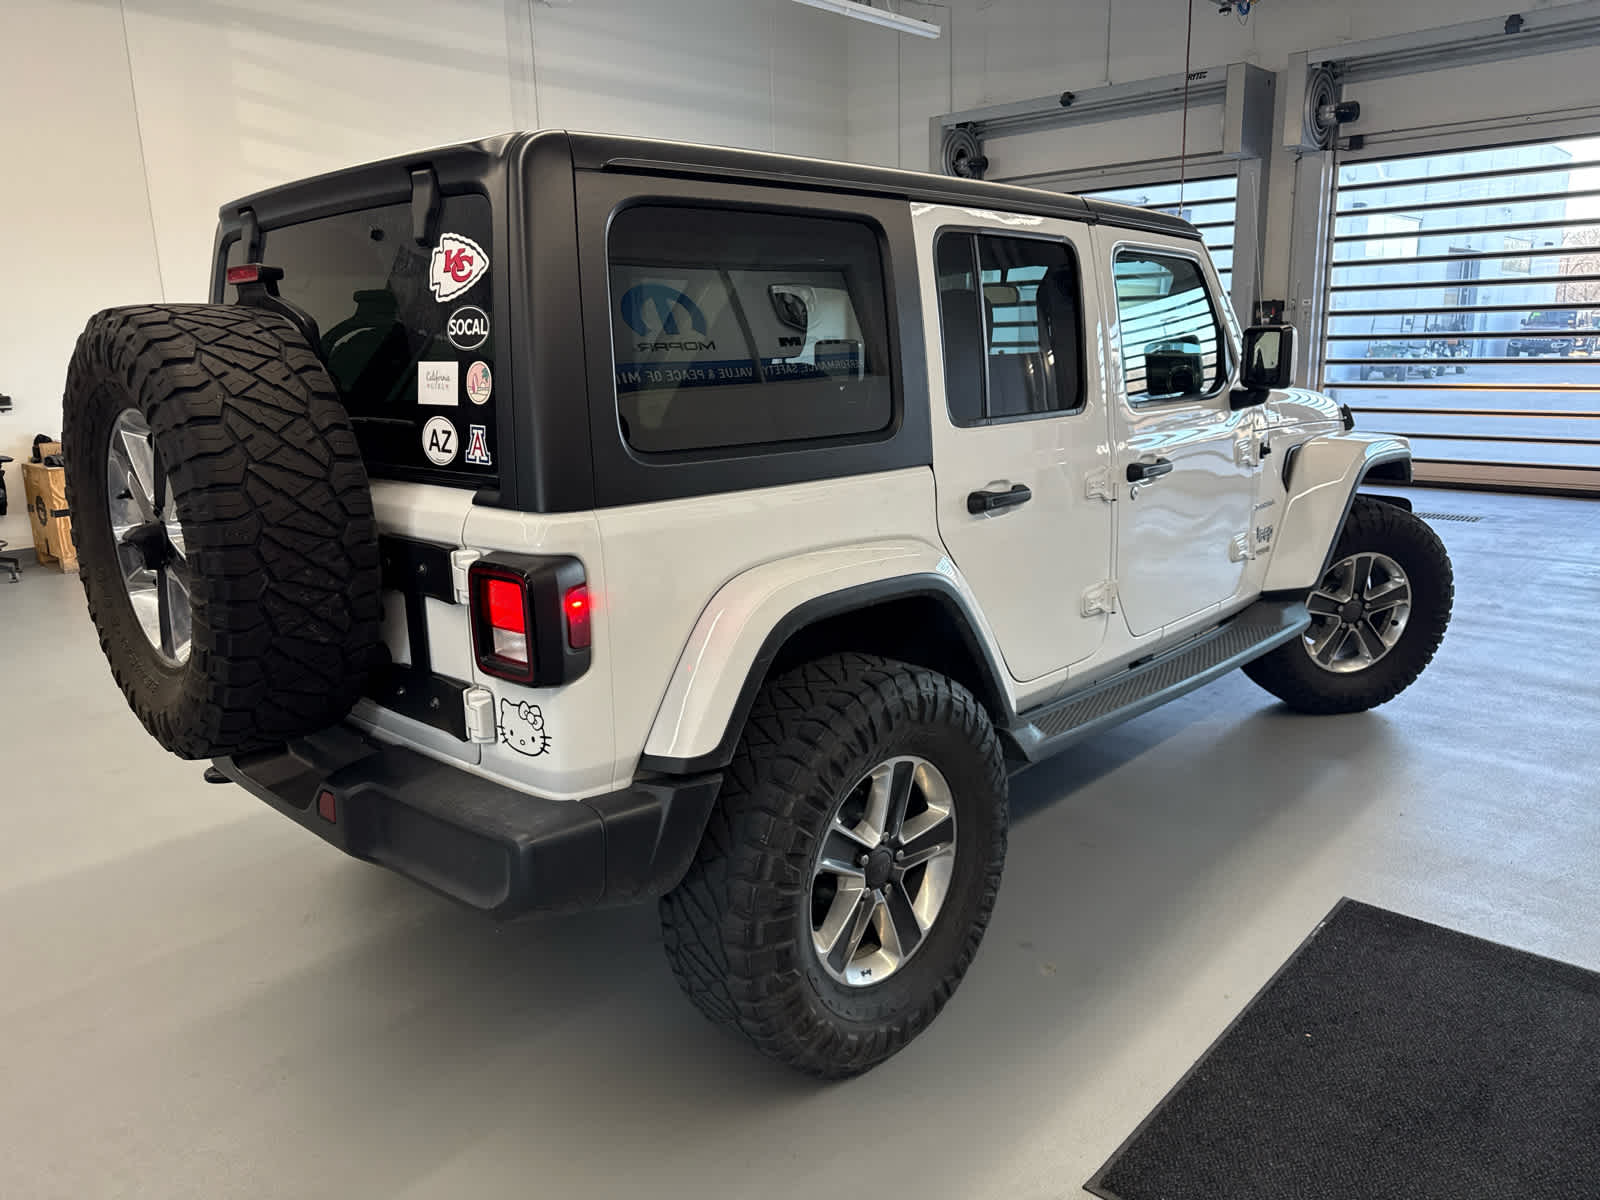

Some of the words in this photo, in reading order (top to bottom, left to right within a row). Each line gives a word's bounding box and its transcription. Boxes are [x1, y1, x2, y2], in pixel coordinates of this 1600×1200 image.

[443, 248, 474, 282] KC
[450, 319, 487, 335] SOCAL
[429, 429, 452, 453] AZ
[466, 424, 491, 465] A
